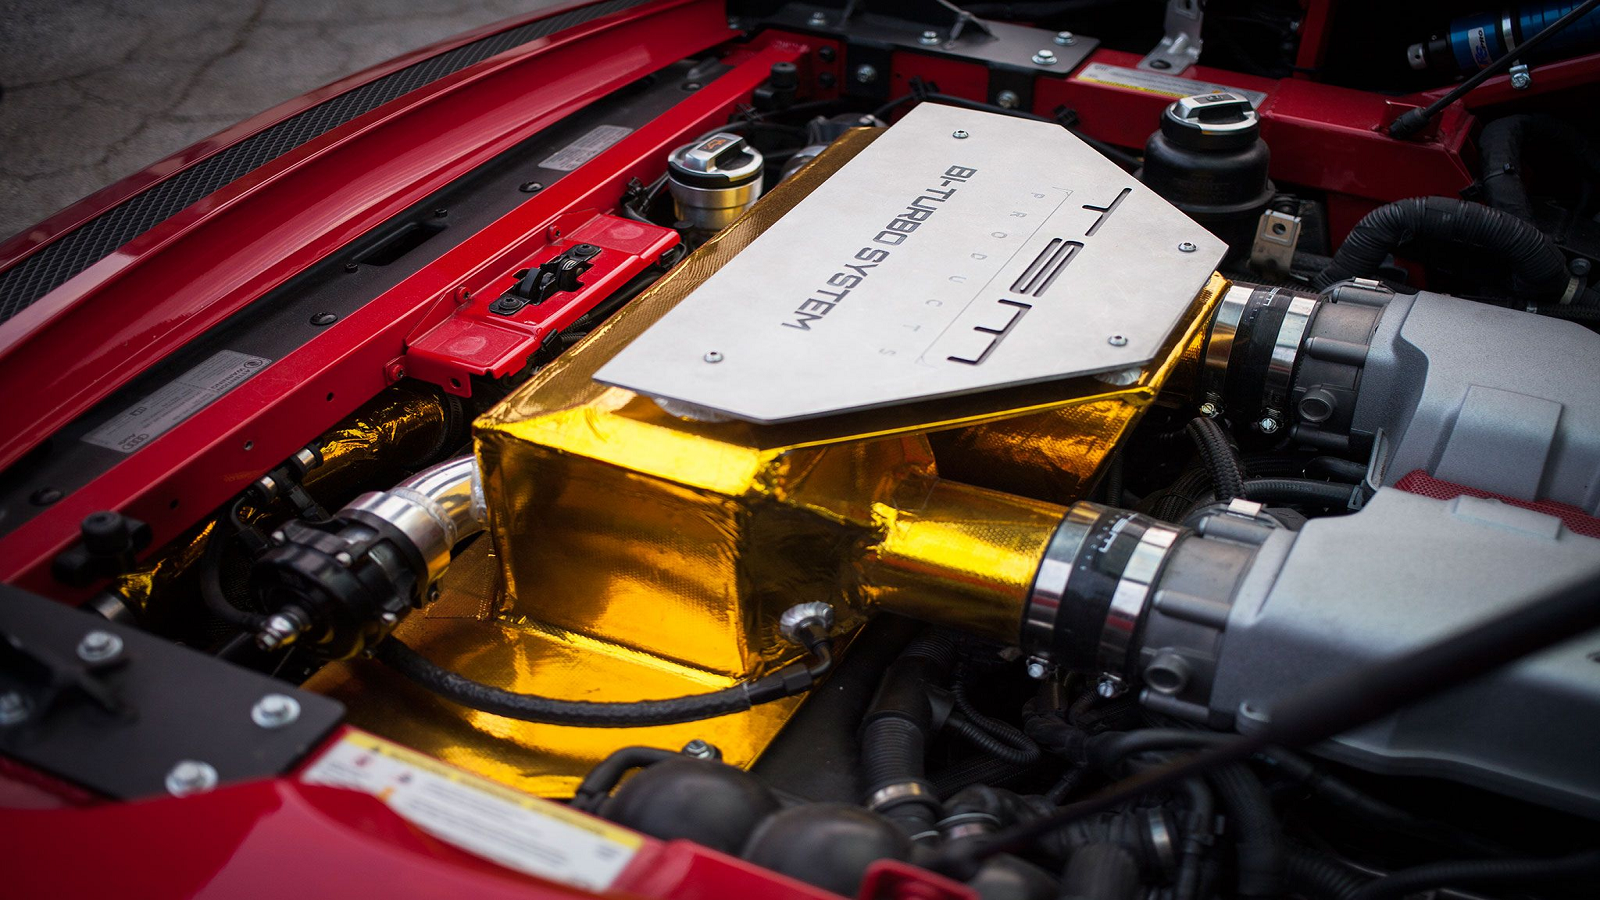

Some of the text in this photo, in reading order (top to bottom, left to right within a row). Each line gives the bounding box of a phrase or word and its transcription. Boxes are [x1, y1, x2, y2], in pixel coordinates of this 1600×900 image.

[781, 165, 978, 331] BI-TURBO SYSTEM
[879, 192, 1046, 357] PRODUCTS
